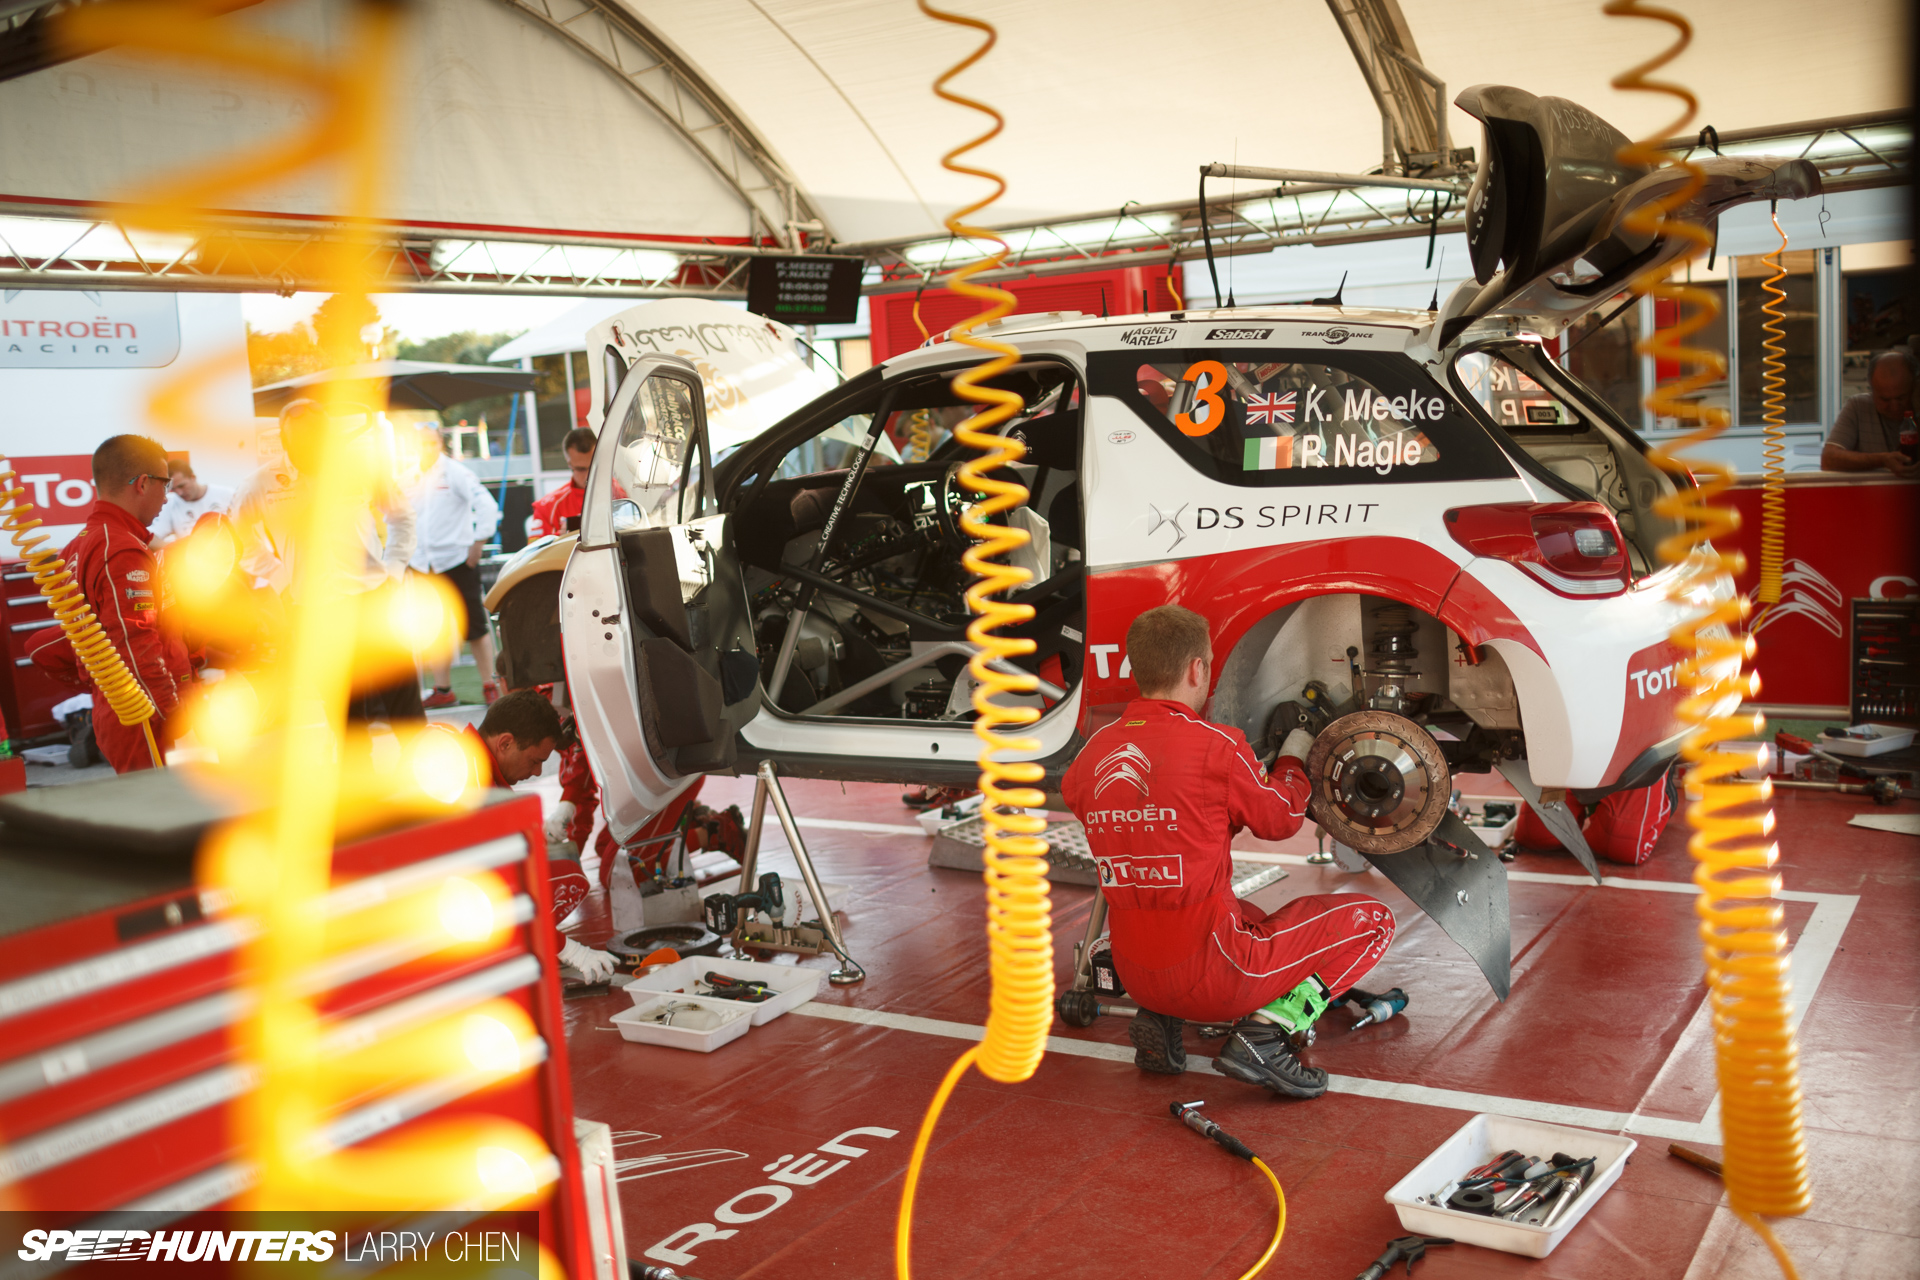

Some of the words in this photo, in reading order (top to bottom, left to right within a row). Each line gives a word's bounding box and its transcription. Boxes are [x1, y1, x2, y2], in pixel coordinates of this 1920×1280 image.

[775, 262, 834, 271] K.MEEKE
[0, 316, 137, 339] ITROËN
[1213, 329, 1266, 340] Sabelt
[8, 343, 139, 354] ACING
[1175, 360, 1228, 437] 3
[1304, 389, 1333, 422] K.
[1343, 388, 1445, 421] Meeke
[1301, 434, 1324, 469] P.
[1334, 432, 1421, 475] Nagle
[20, 473, 96, 509] TO
[822, 505, 841, 540] CREATIVE
[837, 451, 865, 505] TECHNOLOGIE
[1196, 506, 1245, 530] DS
[1256, 503, 1380, 529] SPIRIT
[1113, 861, 1178, 880] TOTAL
[1236, 1032, 1265, 1065] SALOMON
[643, 1126, 900, 1266] ROËN
